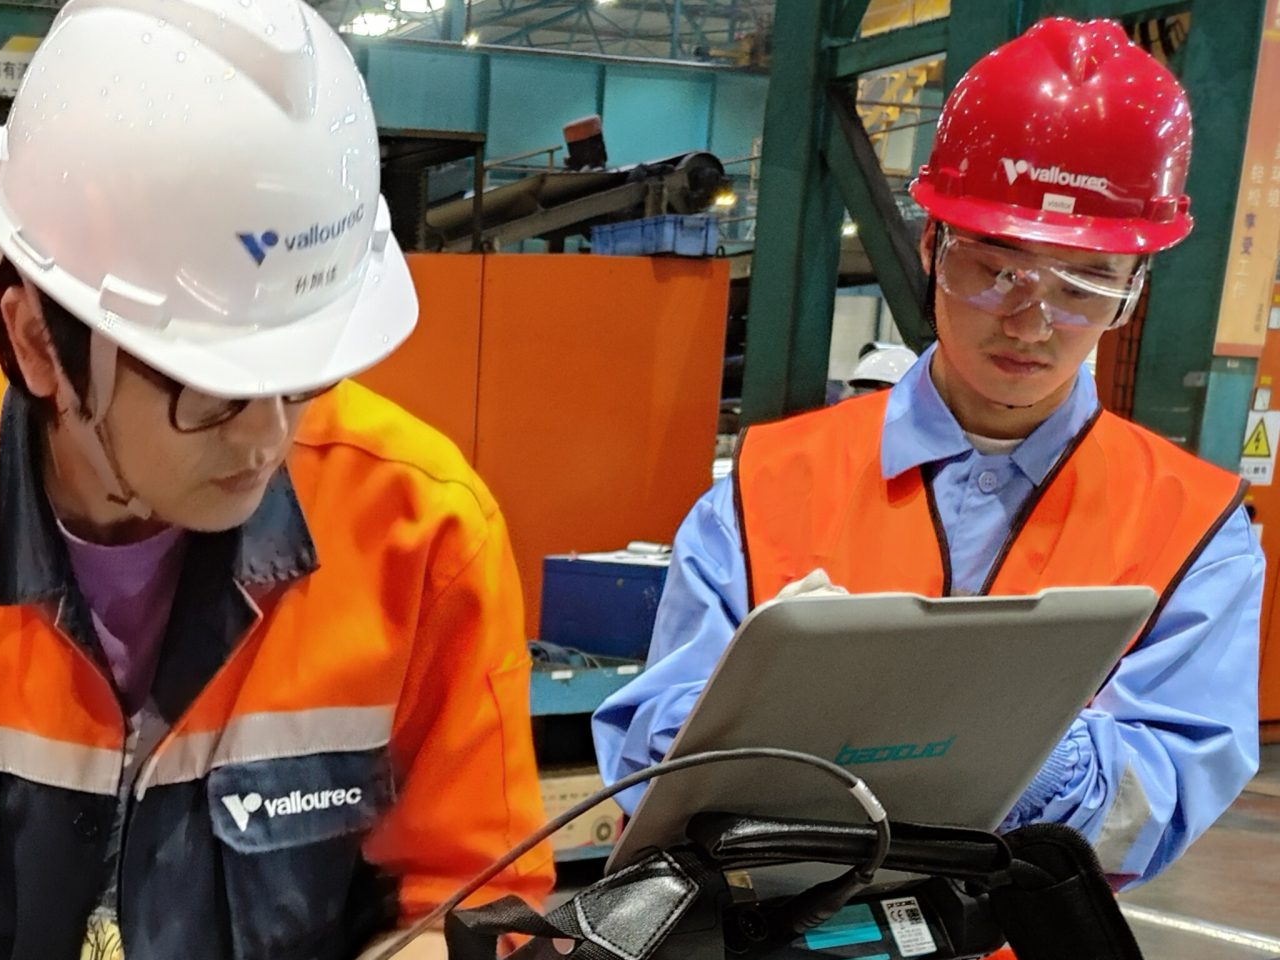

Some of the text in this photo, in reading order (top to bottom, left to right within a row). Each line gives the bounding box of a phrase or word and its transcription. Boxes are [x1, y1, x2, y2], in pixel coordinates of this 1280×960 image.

[1030, 166, 1109, 191] vallourec
[285, 203, 364, 251] vallourec
[264, 787, 362, 818] vallourec
